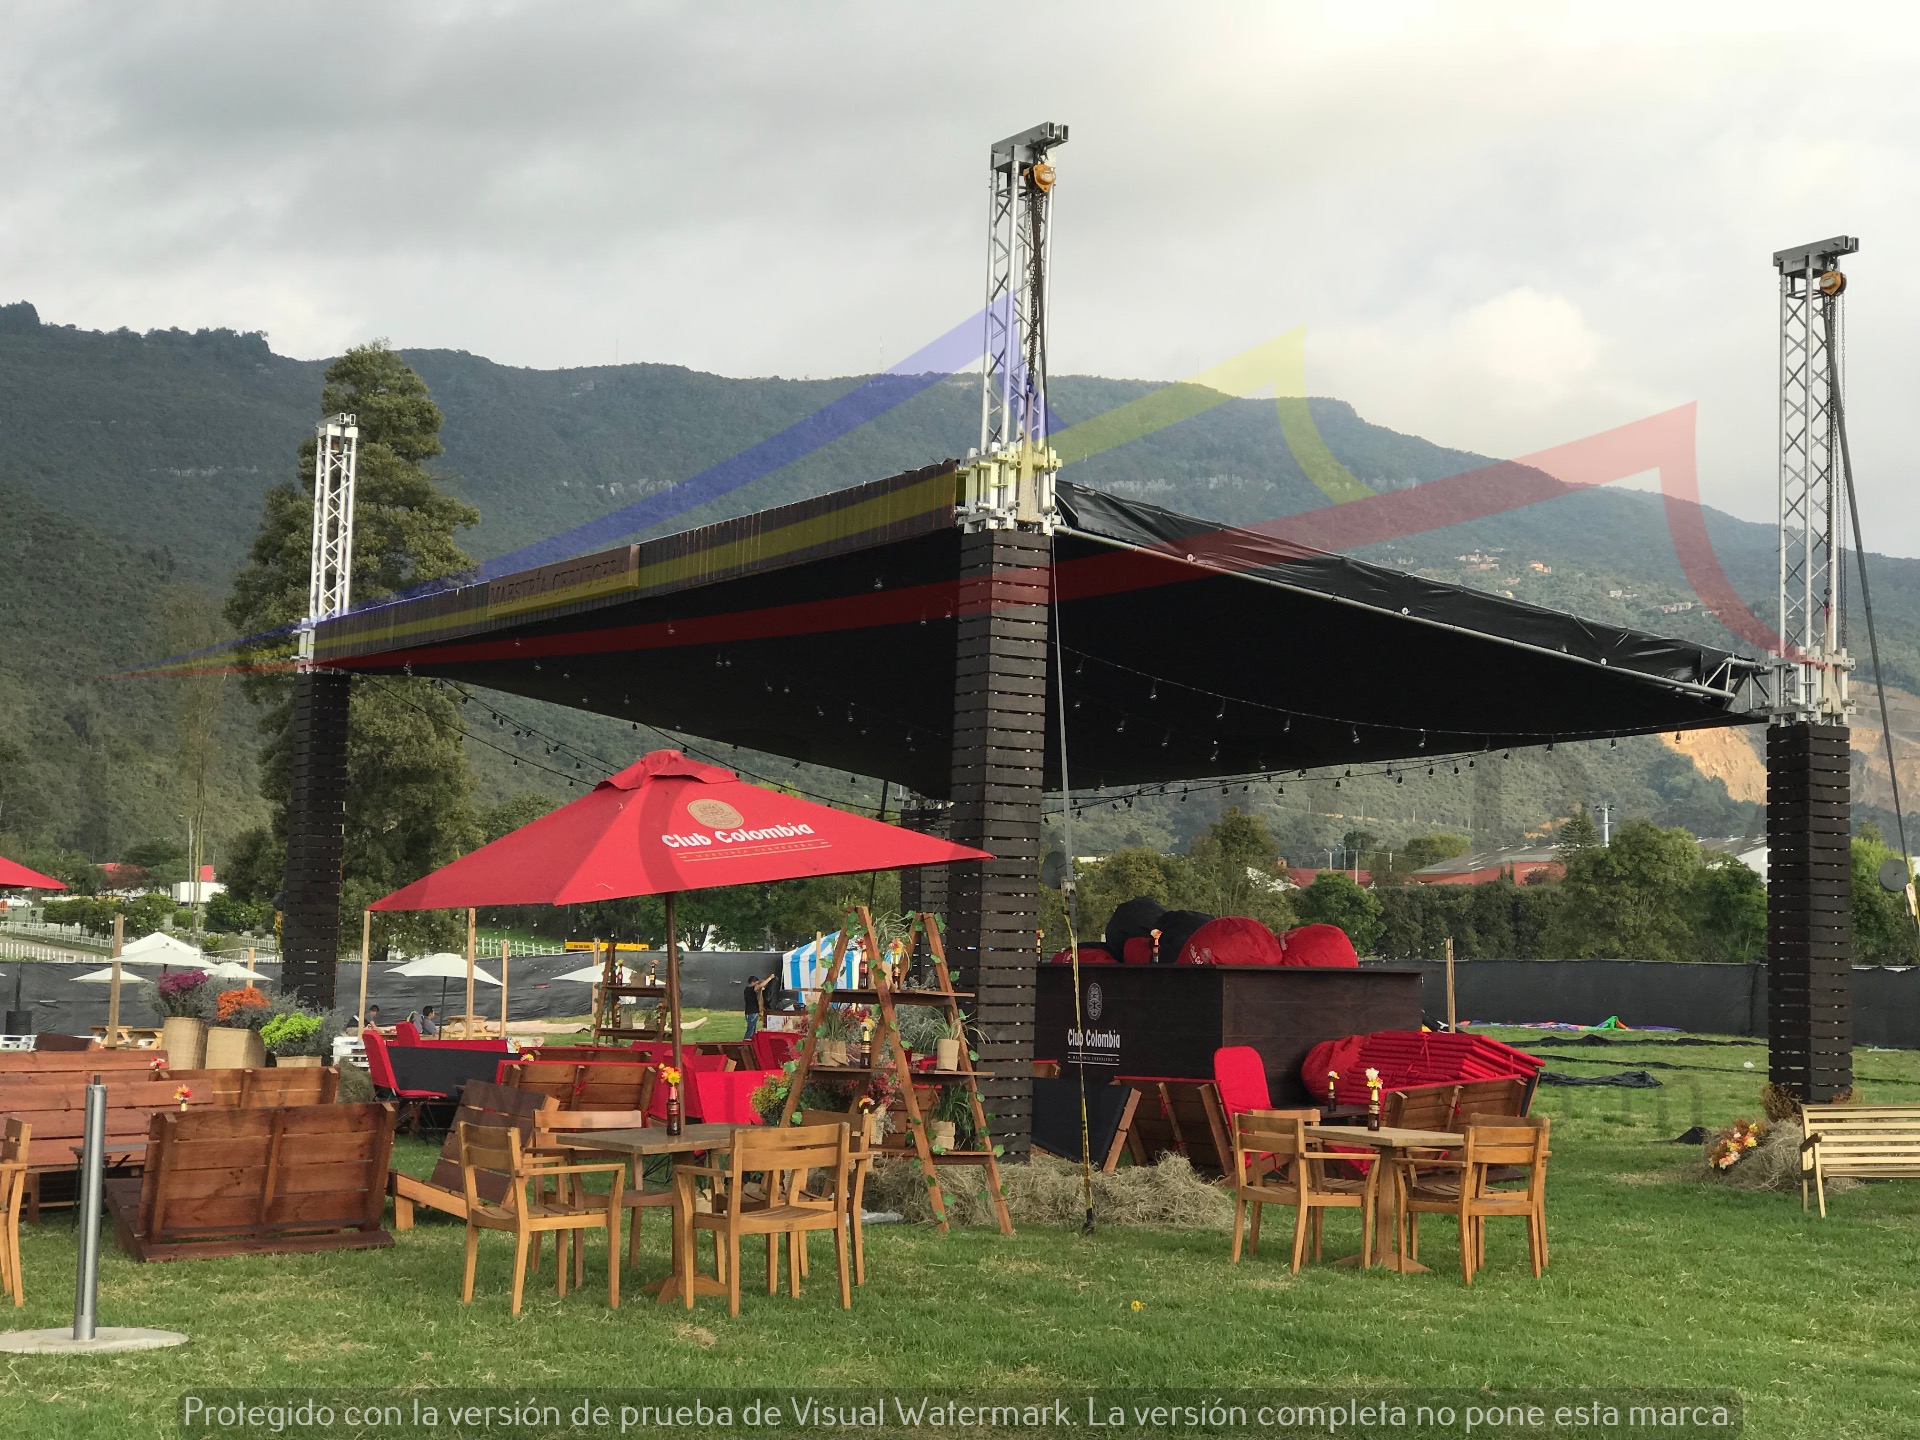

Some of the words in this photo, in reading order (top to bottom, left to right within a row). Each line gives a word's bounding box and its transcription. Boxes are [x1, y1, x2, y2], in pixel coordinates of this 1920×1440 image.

[661, 832, 712, 848] Club
[714, 821, 816, 844] Colombia
[1067, 1028, 1084, 1047] Club
[1085, 1029, 1121, 1049] Colombia
